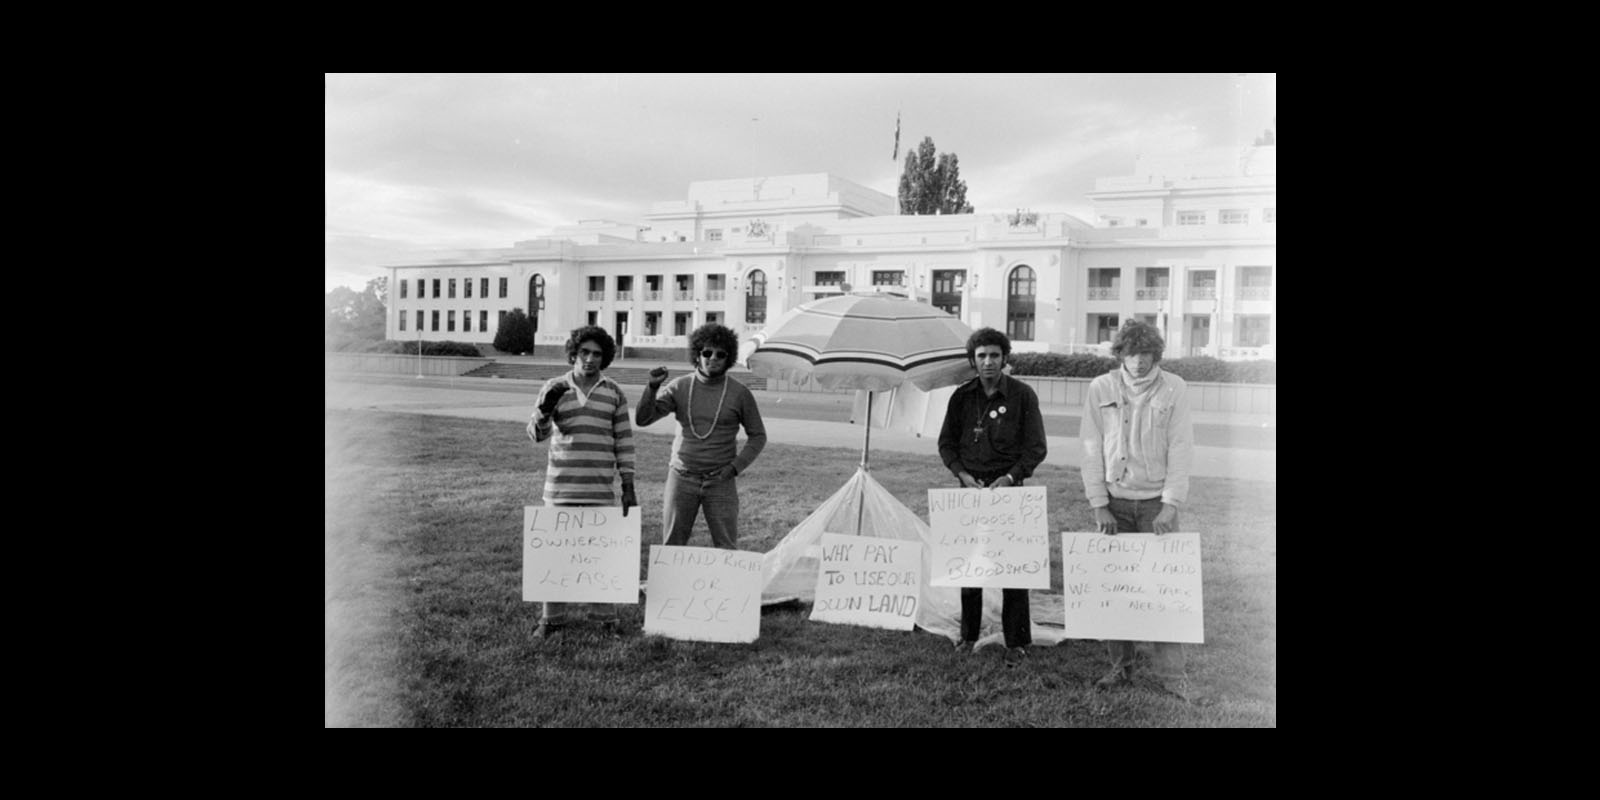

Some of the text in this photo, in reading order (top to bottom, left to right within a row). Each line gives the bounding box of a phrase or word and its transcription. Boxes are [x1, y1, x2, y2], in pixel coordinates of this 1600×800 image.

[931, 492, 981, 512] WHICH
[990, 491, 1012, 506] DO
[529, 508, 607, 532] LAND
[530, 535, 634, 549] OWNERSHIP
[940, 533, 991, 546] LAND
[1068, 535, 1195, 562] LEGALLY THIS
[654, 548, 717, 567] LAND
[822, 543, 899, 564] WHY PAY
[1070, 561, 1196, 576] IS OUR LAND
[539, 569, 624, 591] LEASE
[692, 578, 722, 592] OR
[1069, 583, 1092, 596] WE
[1101, 583, 1146, 594] SHALL
[816, 593, 917, 618] OWN LAND
